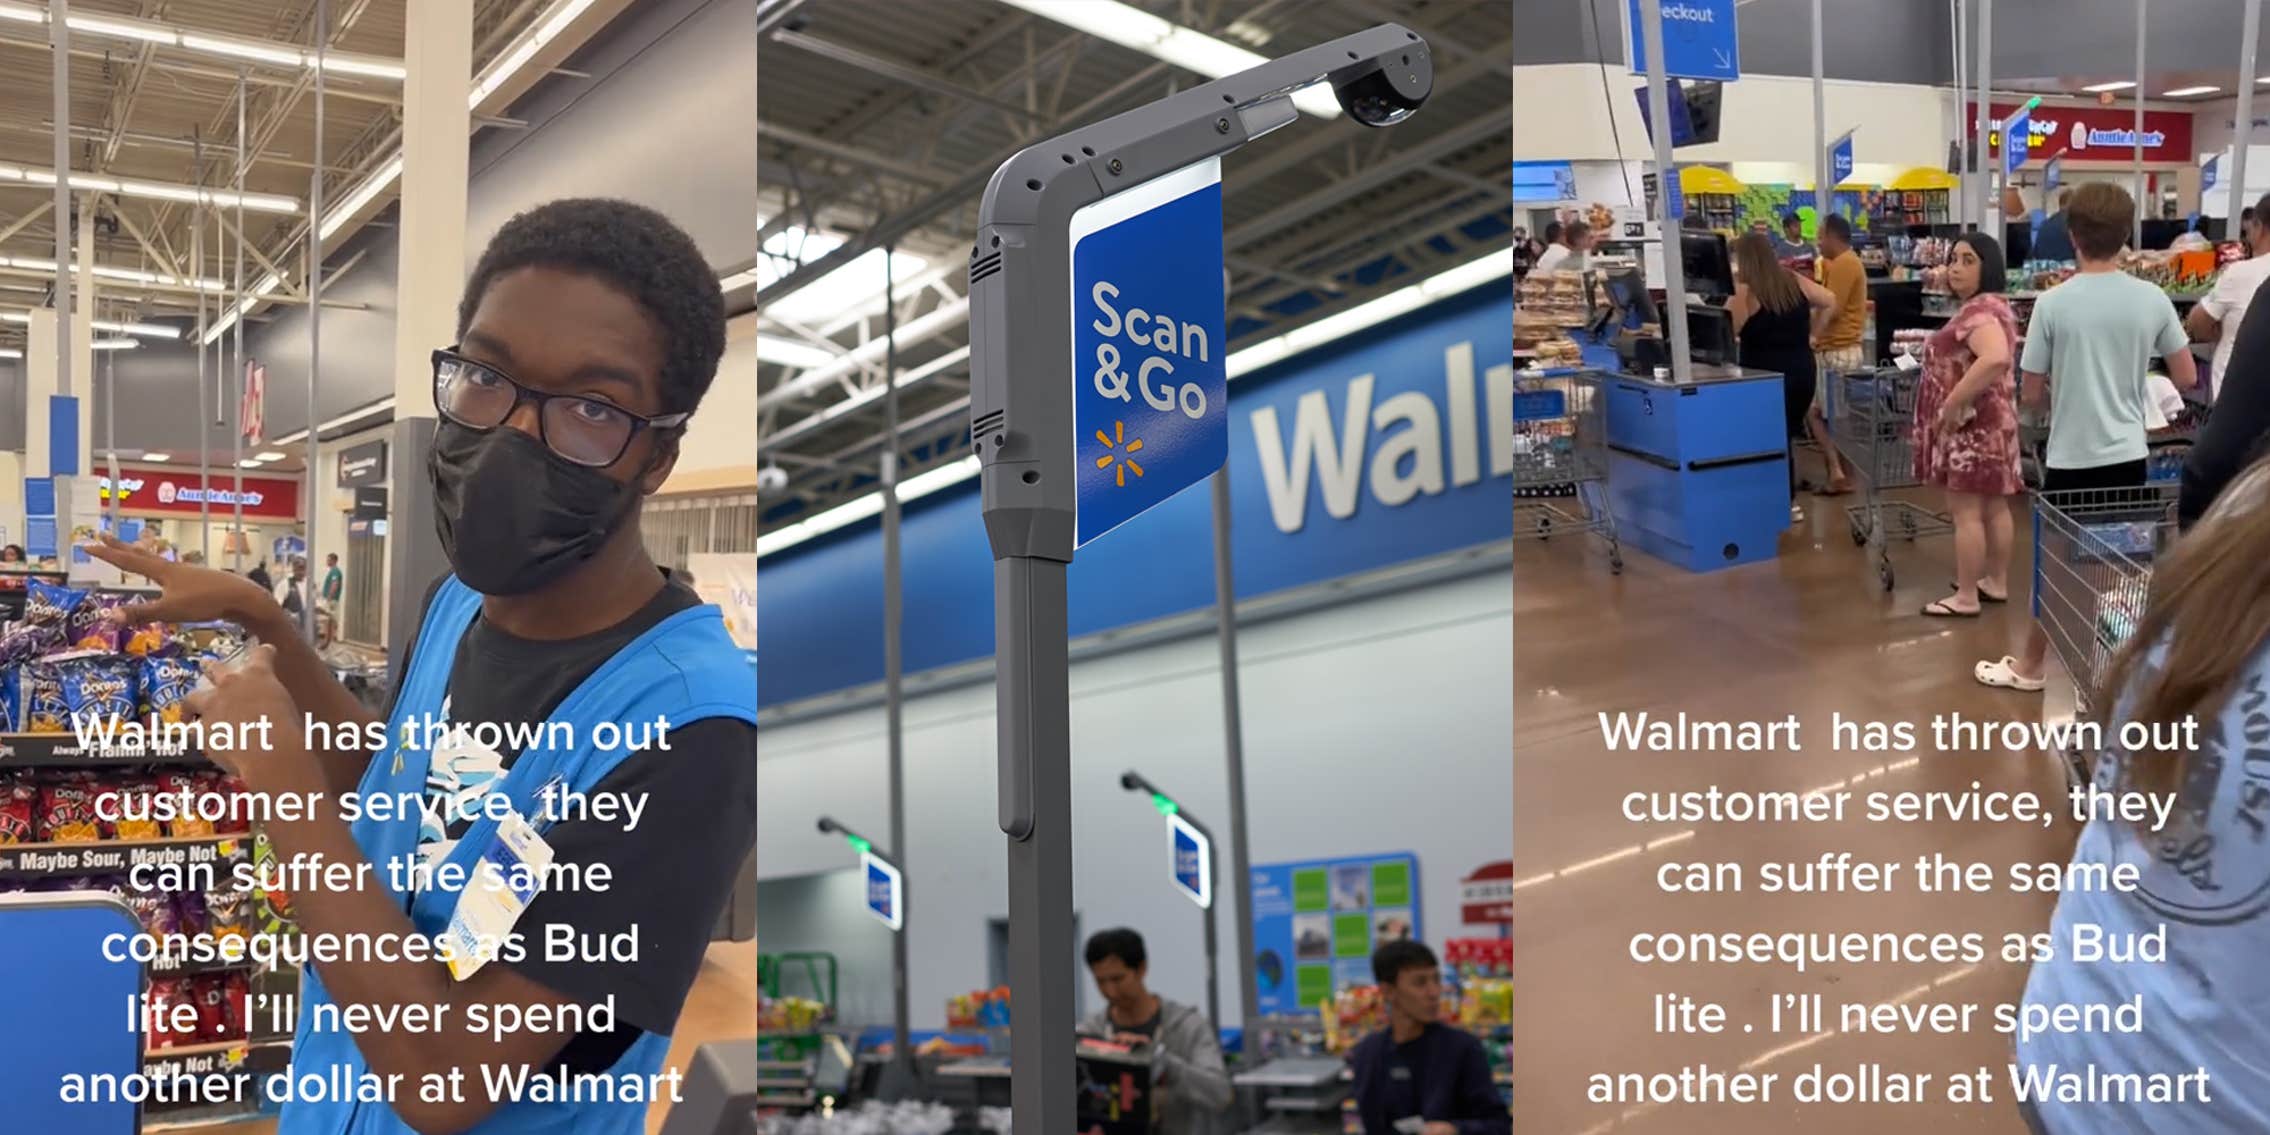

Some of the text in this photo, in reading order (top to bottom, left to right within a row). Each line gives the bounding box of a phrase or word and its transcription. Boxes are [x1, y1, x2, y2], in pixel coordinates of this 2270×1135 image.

[1092, 281, 1209, 363] Scan
[1094, 343, 1208, 420] & Go
[20, 853, 79, 871] Maybe
[83, 849, 126, 867] Sour,
[130, 847, 186, 866] Maybe
[189, 844, 217, 862] Not
[186, 1056, 213, 1073] Not
